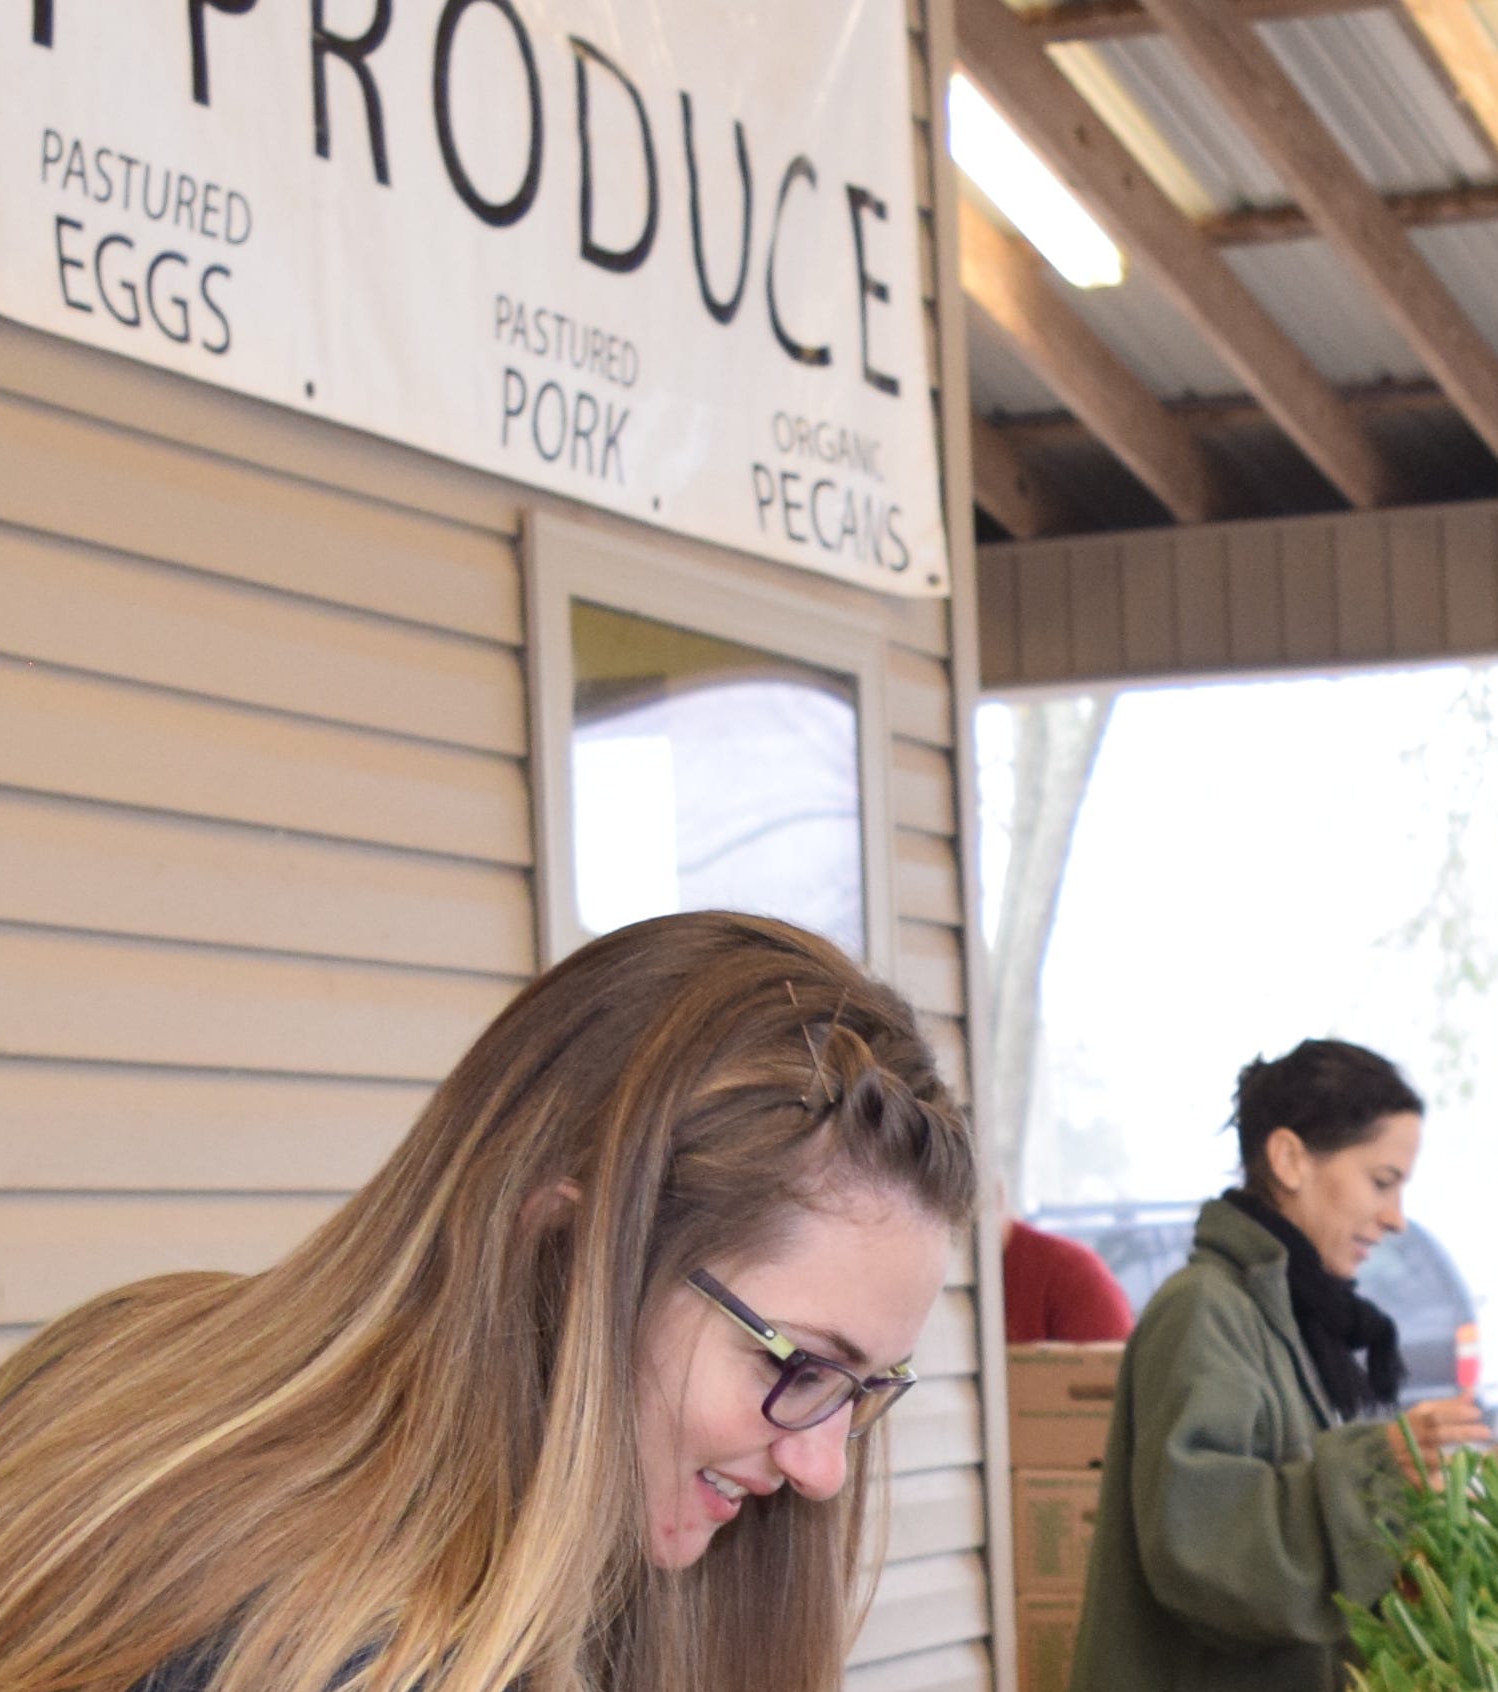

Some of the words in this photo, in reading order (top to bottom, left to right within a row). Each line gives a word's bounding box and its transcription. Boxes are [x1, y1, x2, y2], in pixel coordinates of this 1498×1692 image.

[41, 128, 251, 246] PASTURED
[55, 214, 232, 355] EGGS
[495, 294, 638, 388] PASTURED
[503, 367, 630, 485] PORK
[773, 411, 882, 482] ORGANIC
[752, 462, 910, 572] PECANS
